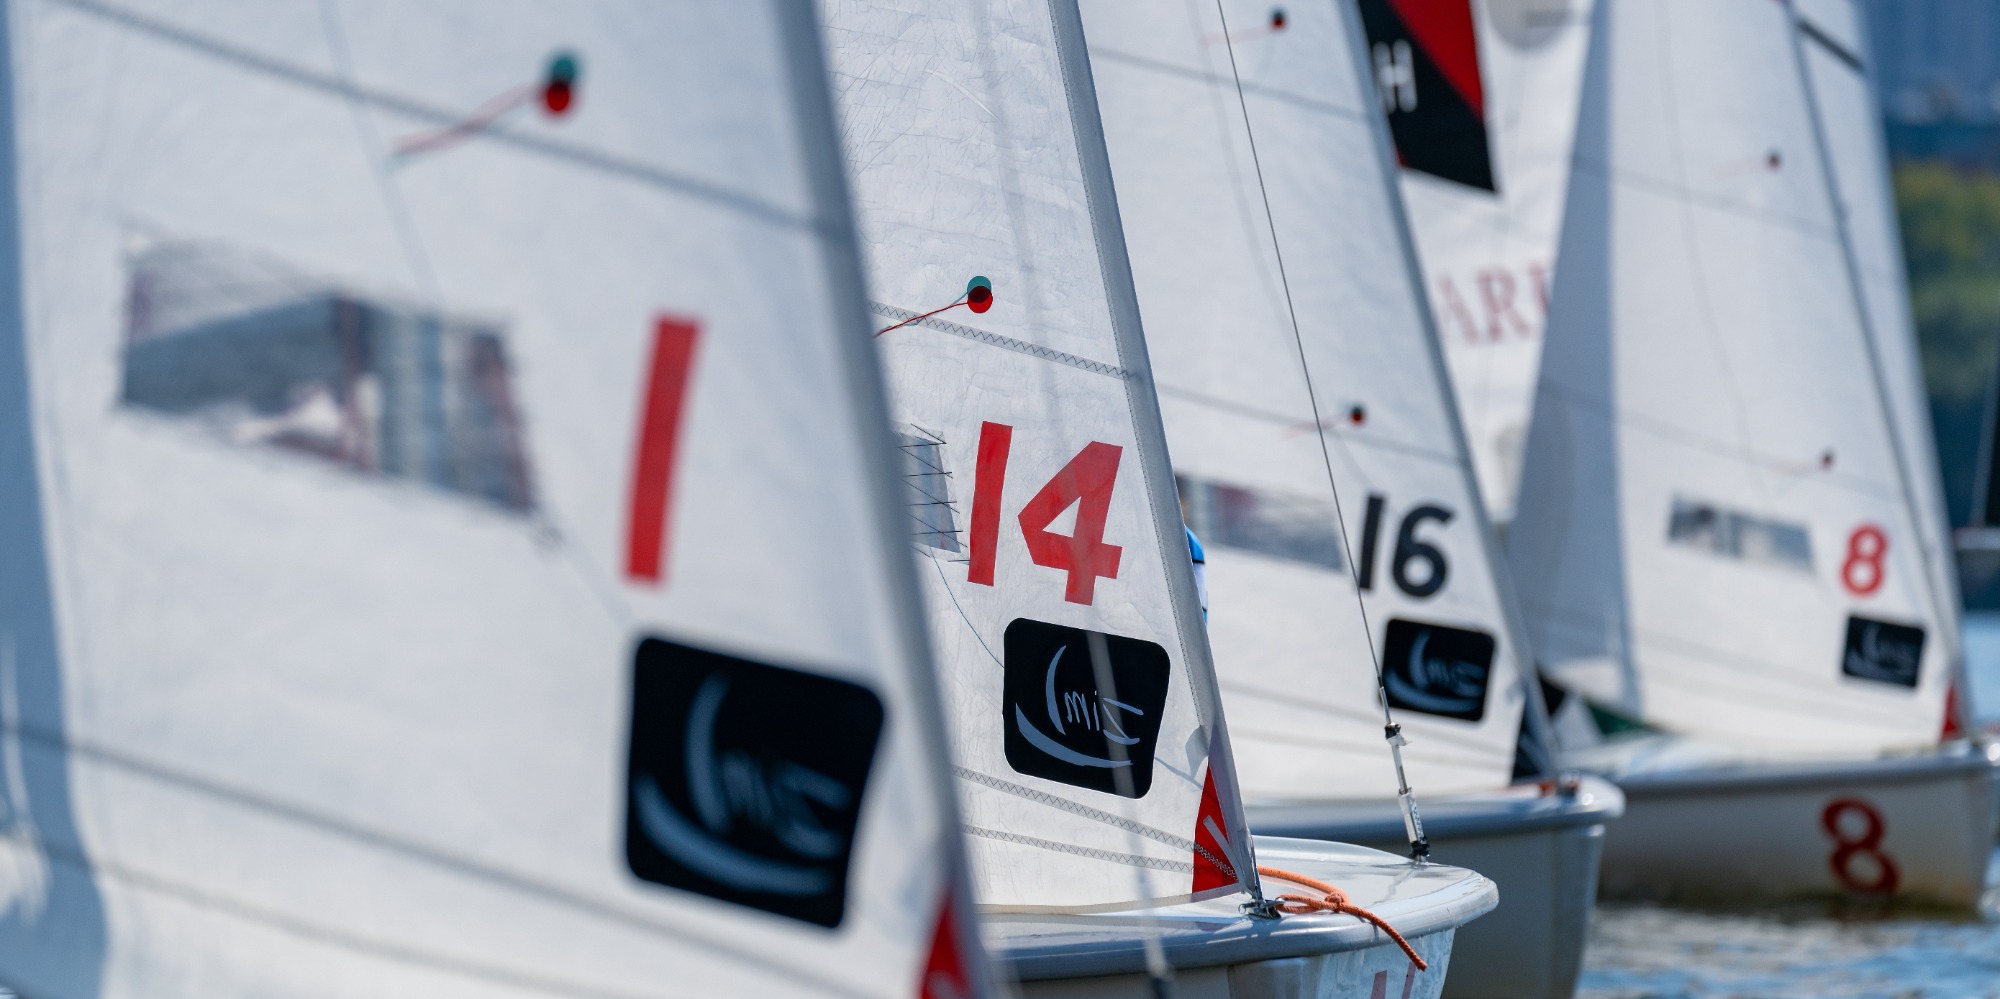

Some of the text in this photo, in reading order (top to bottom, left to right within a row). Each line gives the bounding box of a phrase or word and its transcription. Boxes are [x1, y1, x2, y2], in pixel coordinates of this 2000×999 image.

[620, 314, 702, 587] 1
[967, 420, 1124, 606] 14
[1355, 493, 1455, 598] 16
[1840, 524, 1888, 597] 8
[1820, 798, 1900, 894] 8
